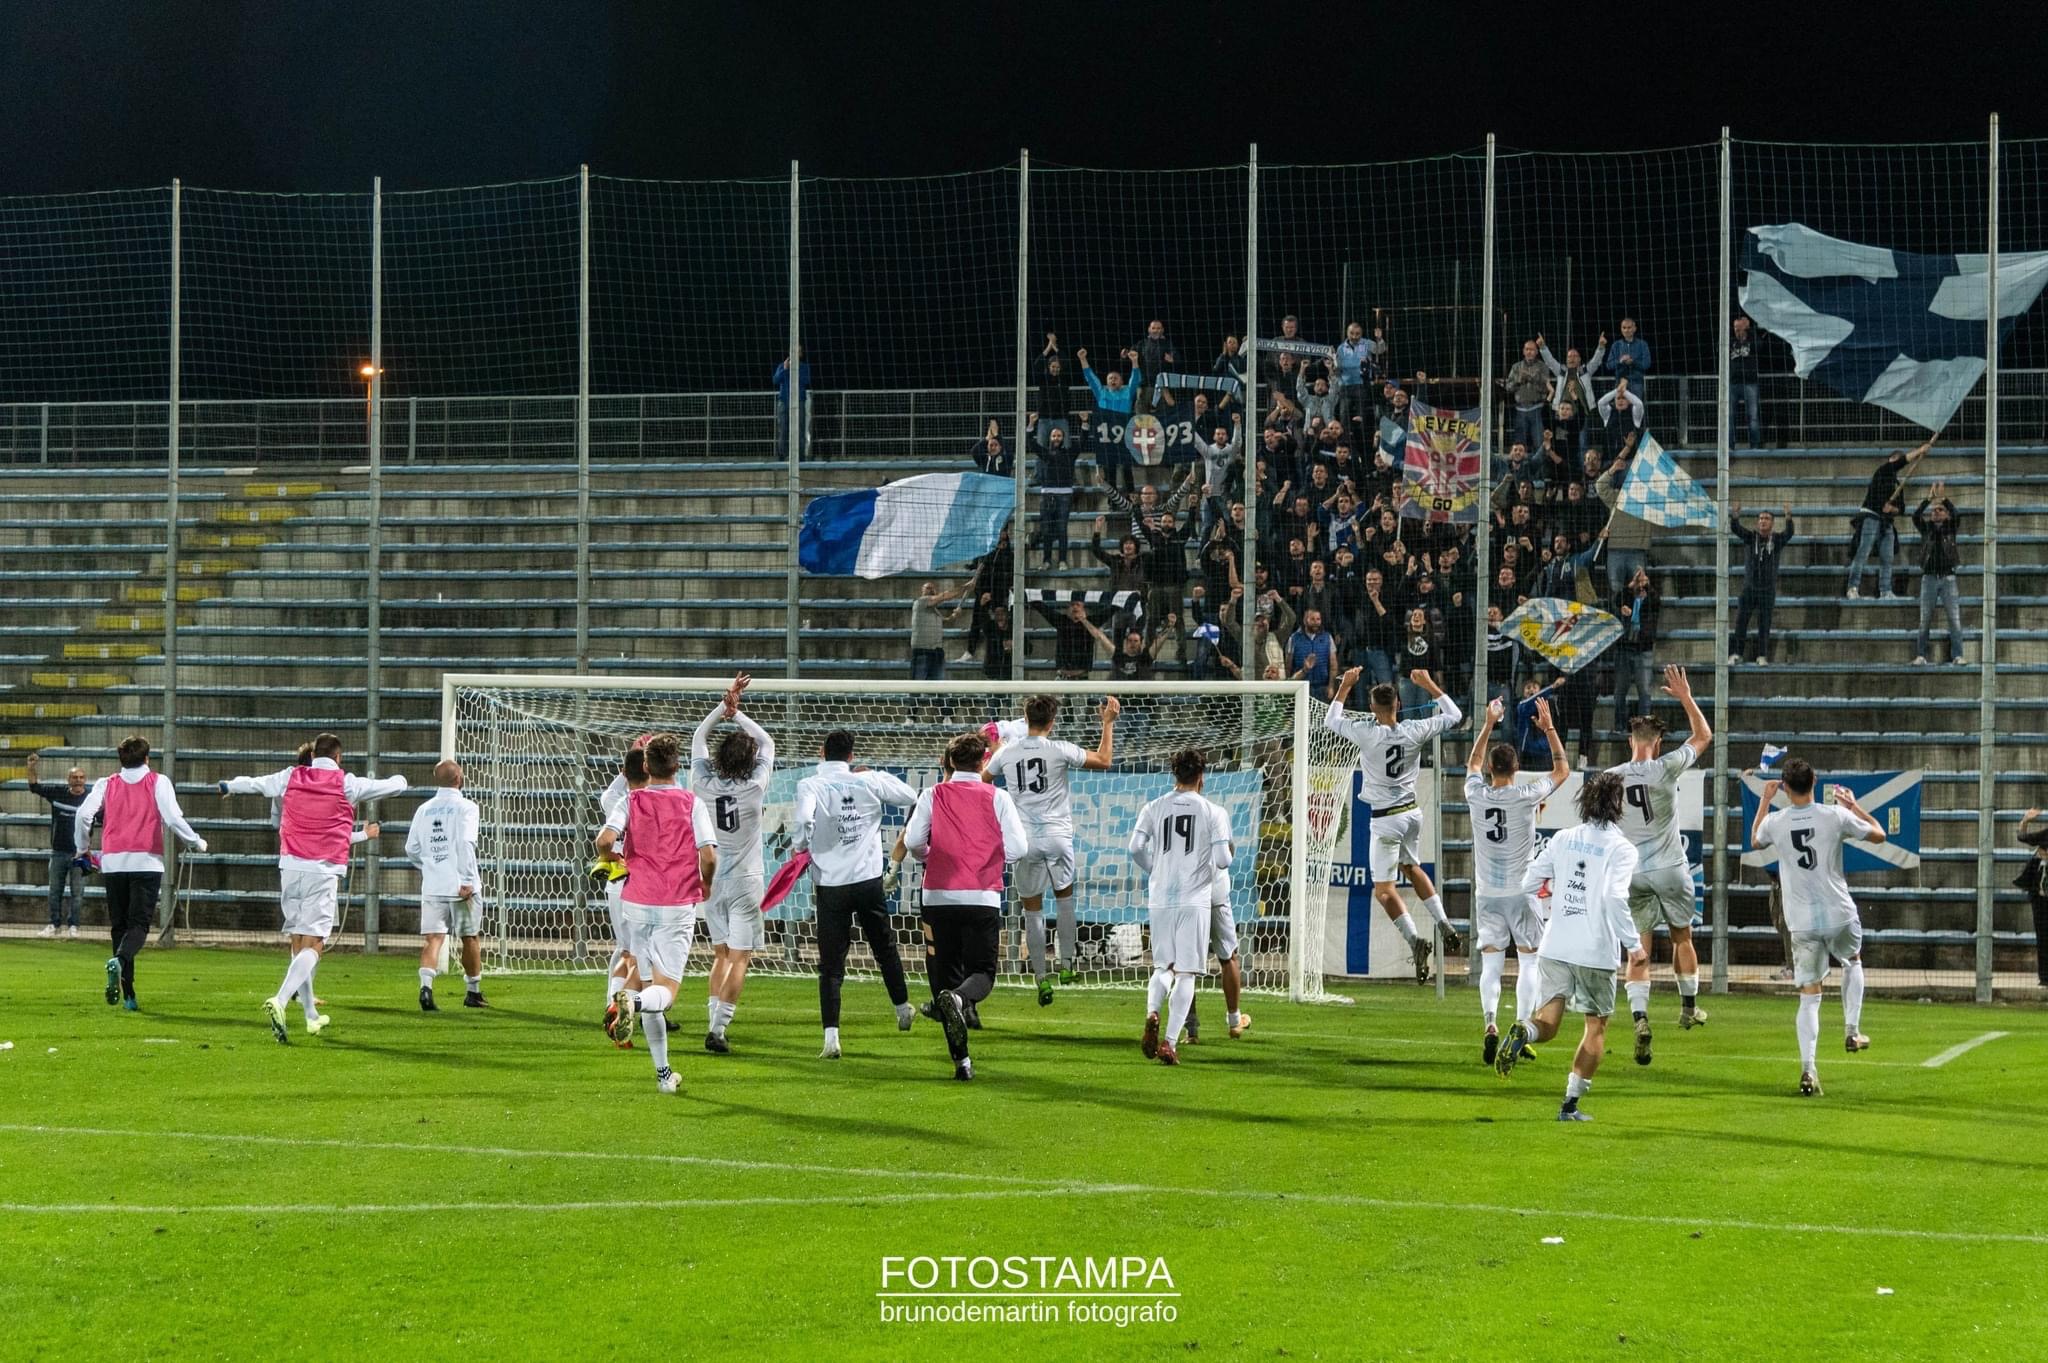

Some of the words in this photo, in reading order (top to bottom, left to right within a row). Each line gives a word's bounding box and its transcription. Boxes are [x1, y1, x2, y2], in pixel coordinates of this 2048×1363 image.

[1432, 497, 1453, 511] GO
[1016, 757, 1049, 795] 13
[1386, 744, 1405, 779] 2
[716, 795, 741, 834] 6
[1626, 784, 1655, 826] 9
[1163, 814, 1196, 856] 19
[1485, 807, 1508, 844] 3
[1790, 828, 1818, 871] 5
